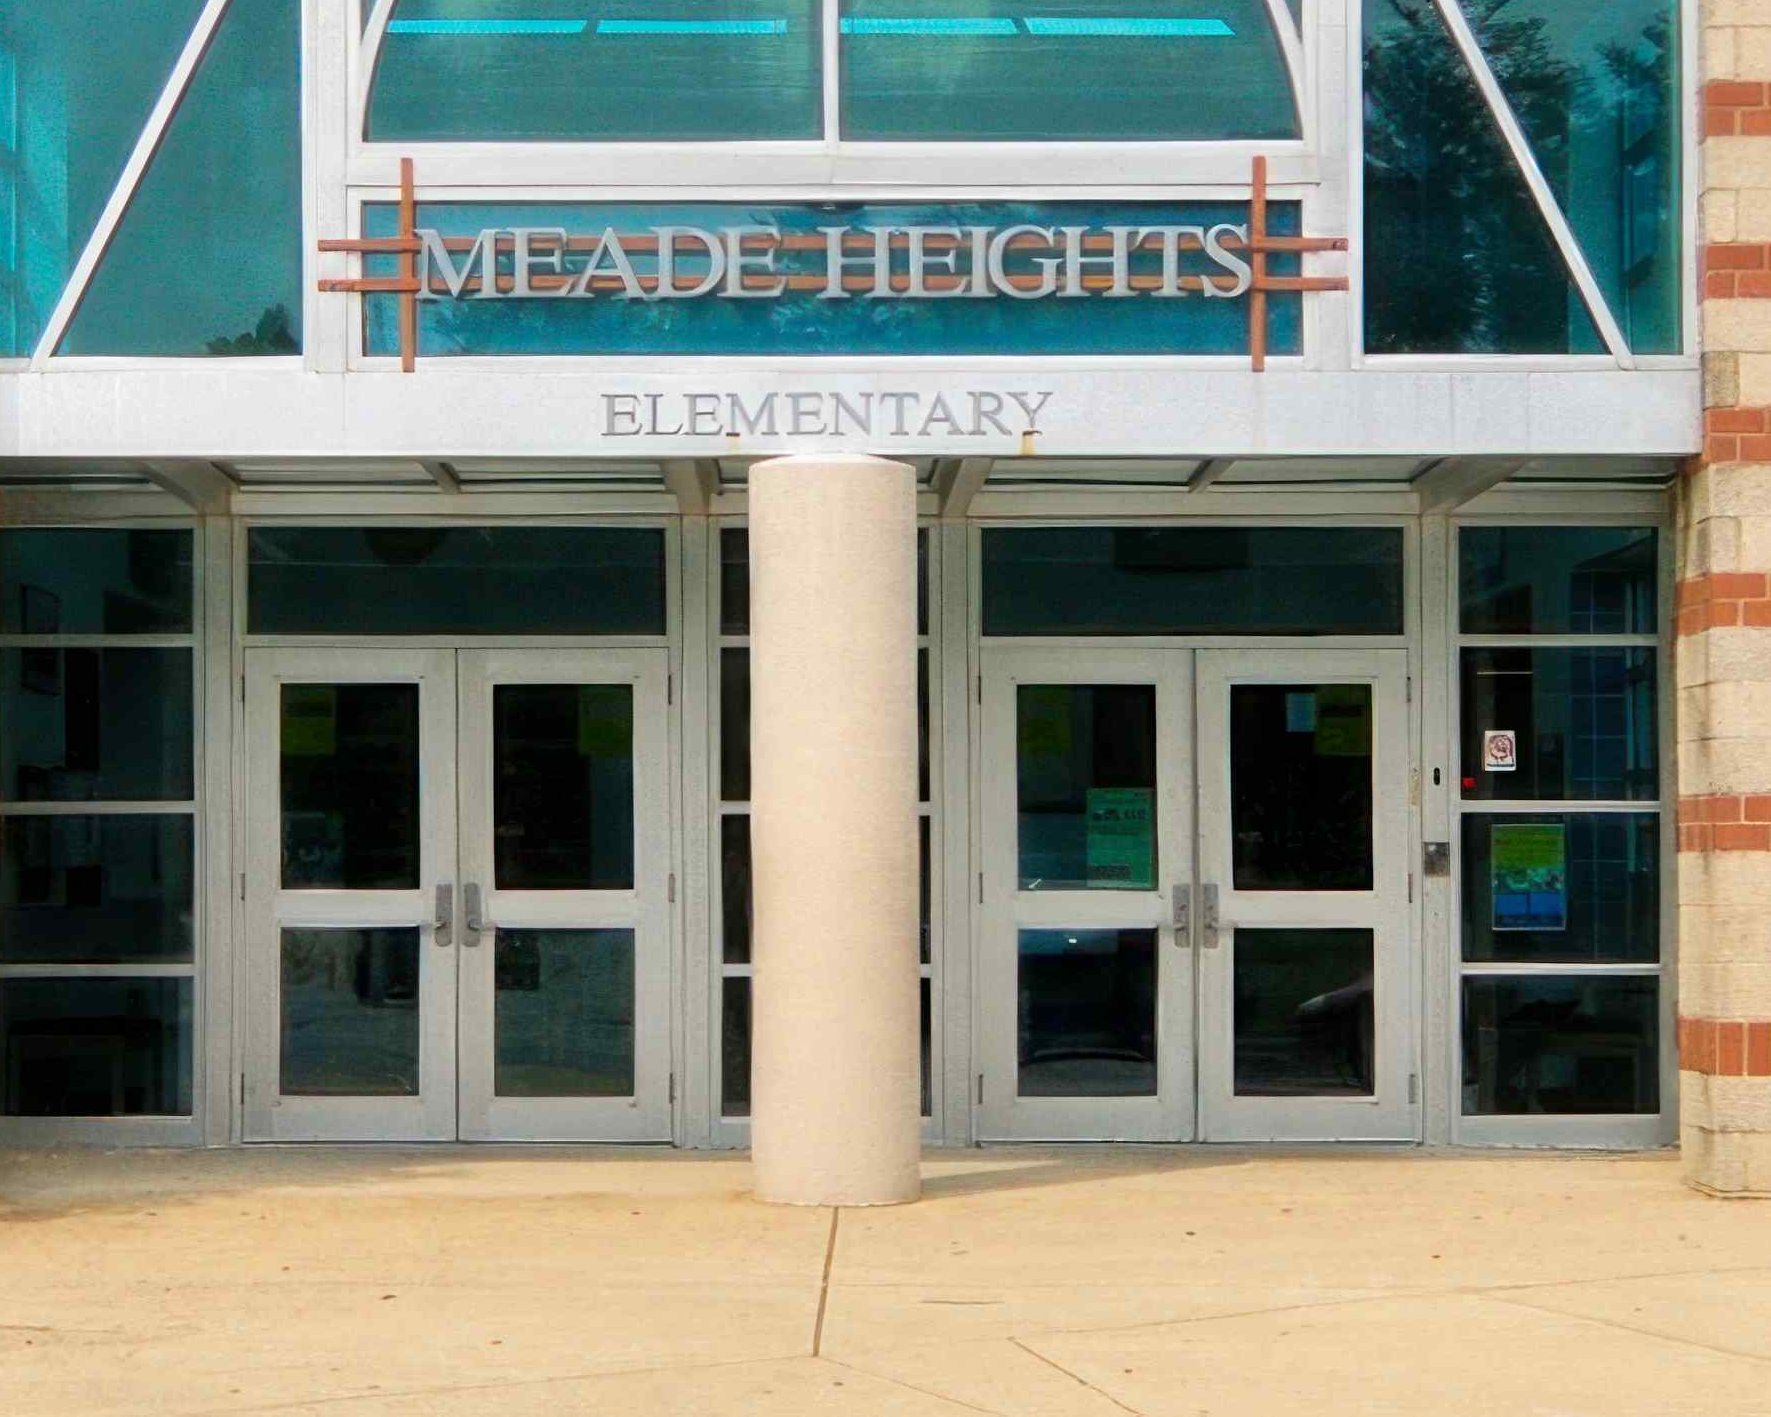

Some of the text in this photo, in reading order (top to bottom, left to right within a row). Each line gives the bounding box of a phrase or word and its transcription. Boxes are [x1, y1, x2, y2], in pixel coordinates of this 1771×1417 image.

[415, 223, 1253, 300] MEADE HEIGHTS
[600, 390, 1054, 437] ELEMENTARY
